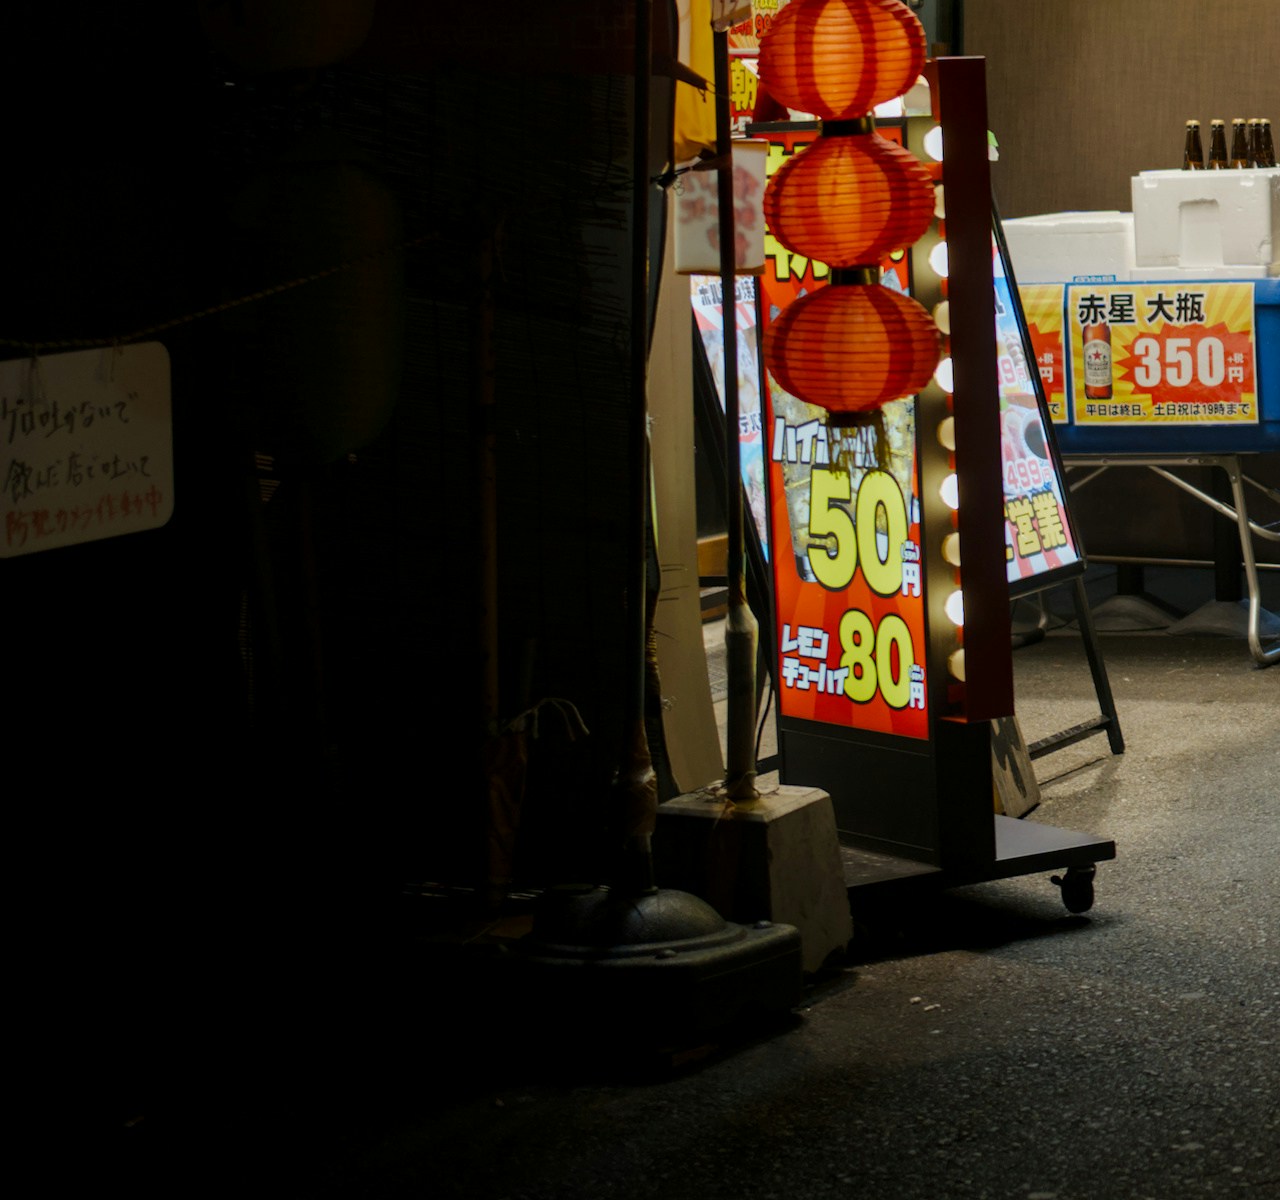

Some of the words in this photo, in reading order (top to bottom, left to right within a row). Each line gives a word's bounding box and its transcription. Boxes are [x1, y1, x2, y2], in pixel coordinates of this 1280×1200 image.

[1079, 294, 1135, 324] 赤星
[1147, 293, 1205, 323] 大瓶
[1134, 336, 1225, 388] 350
[1228, 365, 1245, 383] 円
[807, 465, 909, 598] 50
[1006, 492, 1067, 560] 営業
[781, 623, 830, 660] レモン
[839, 608, 915, 710] 80
[782, 656, 849, 696] チューハイ
